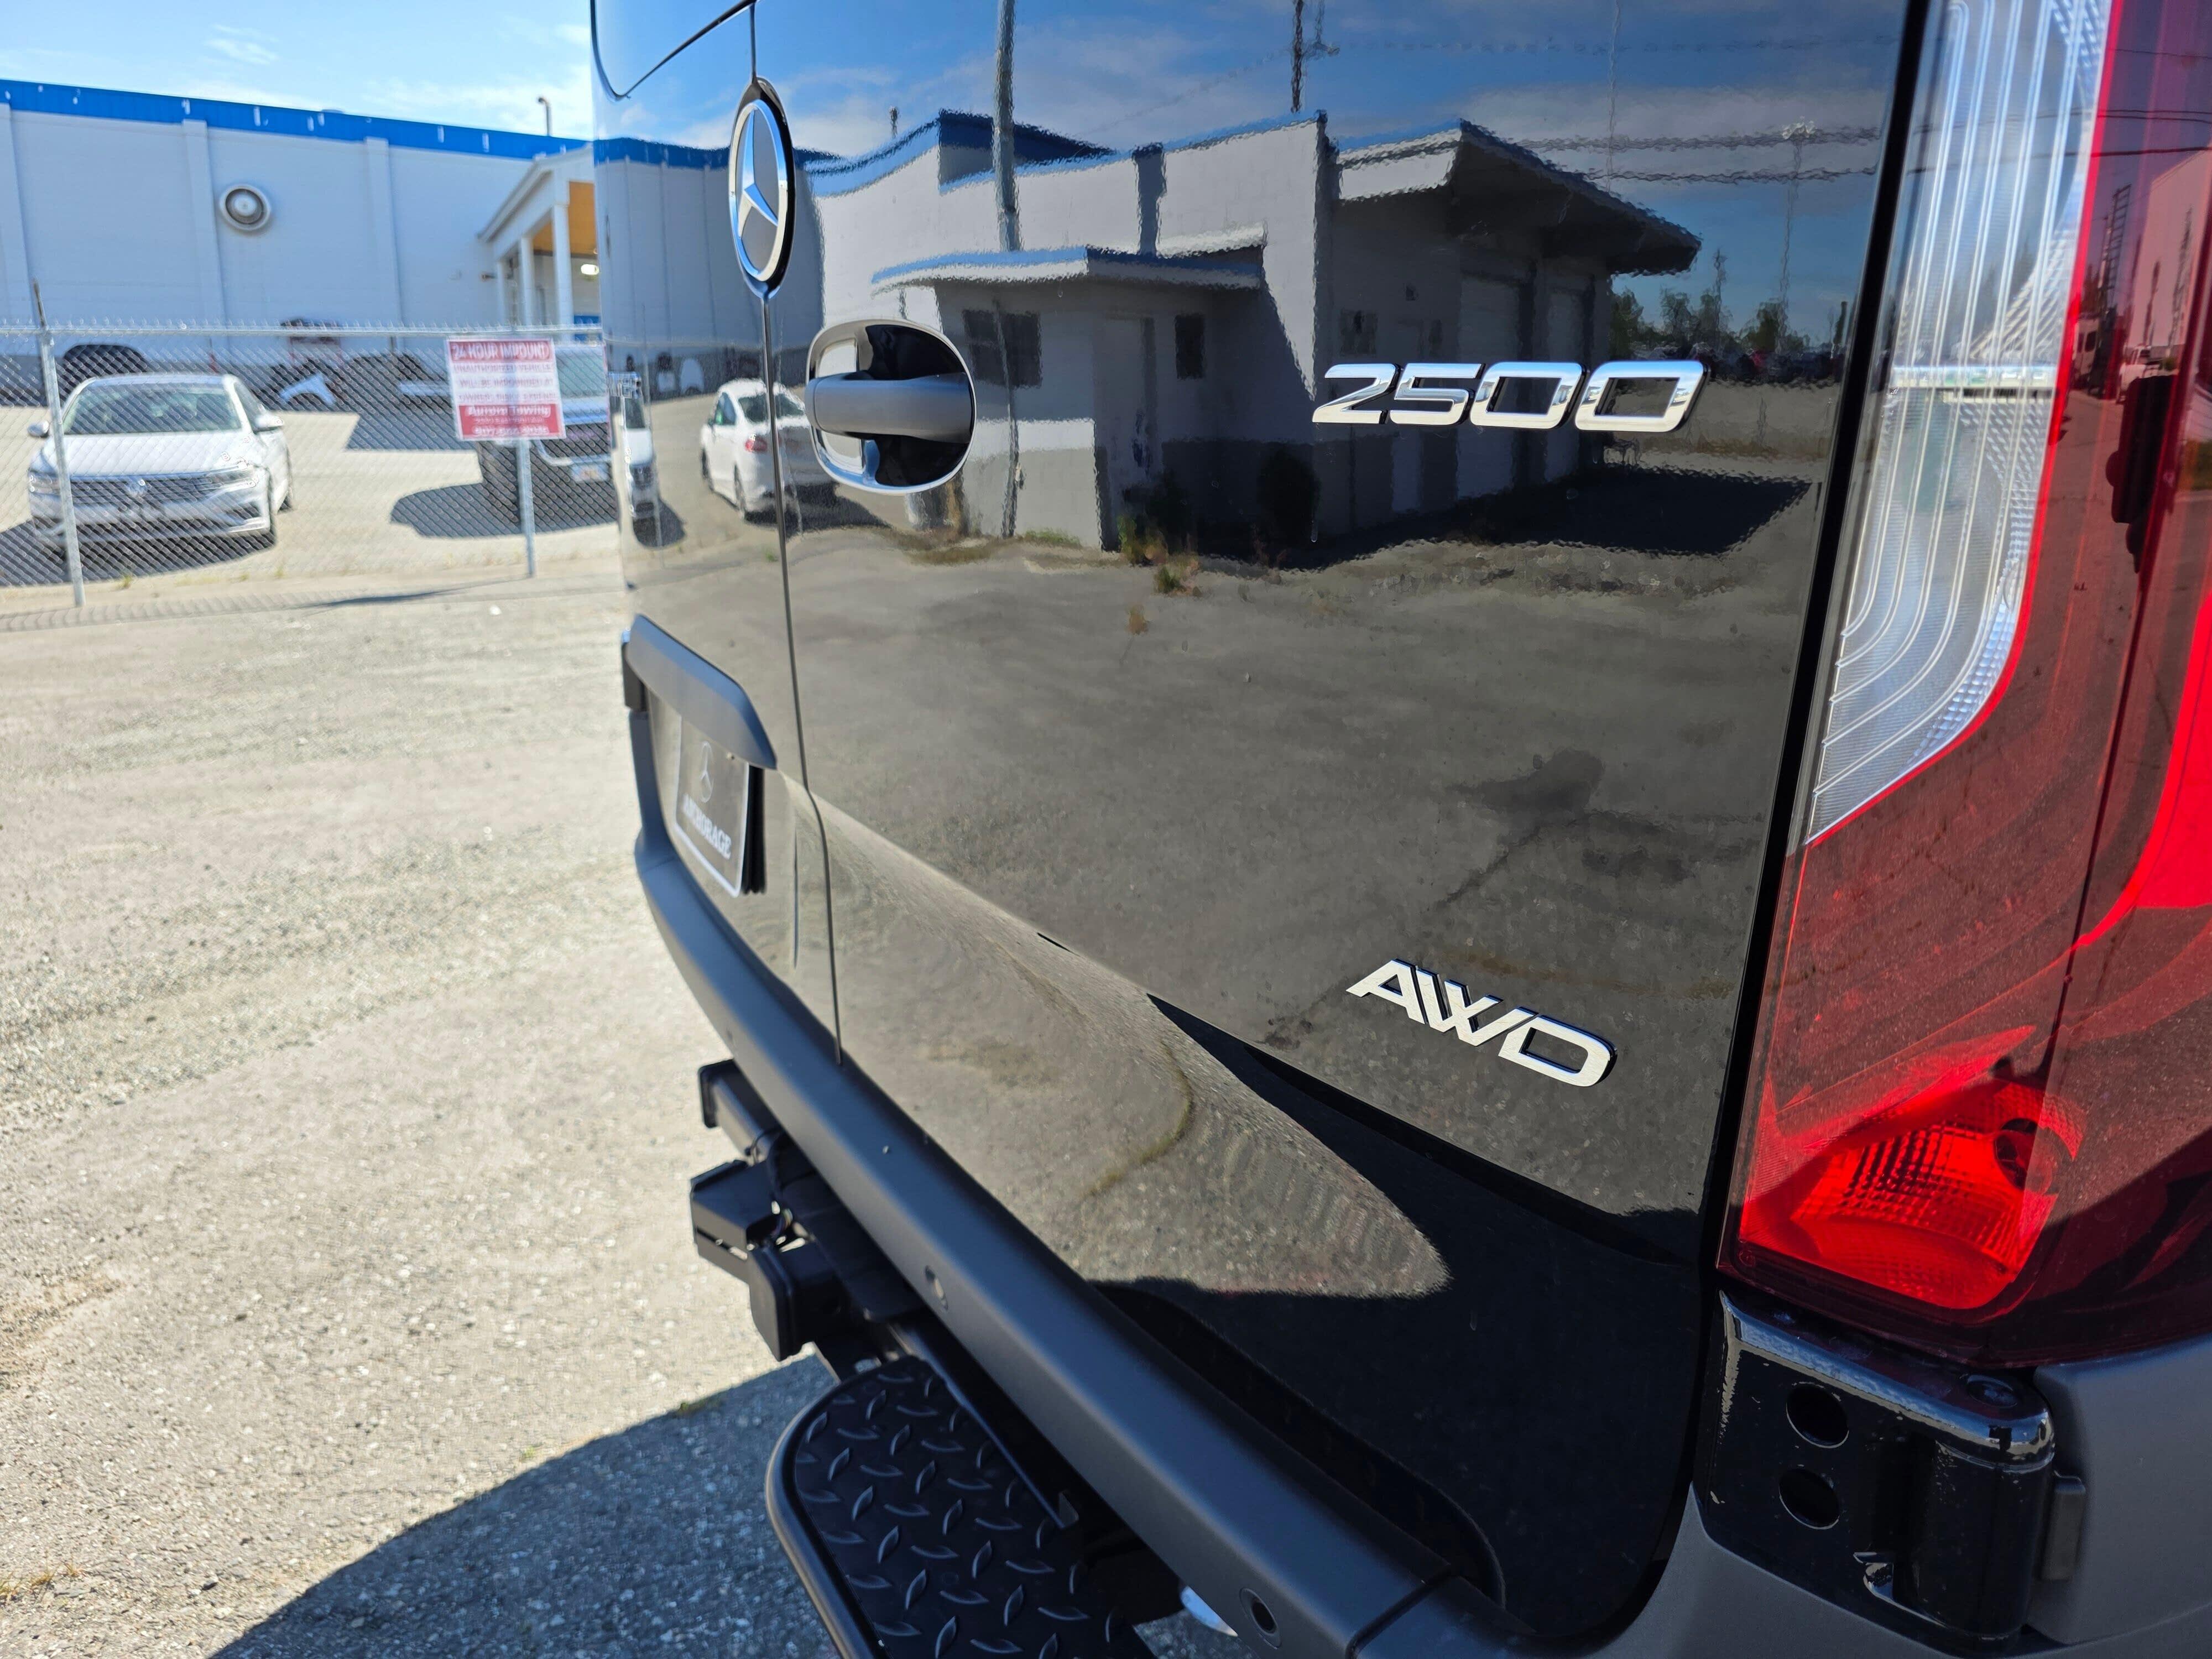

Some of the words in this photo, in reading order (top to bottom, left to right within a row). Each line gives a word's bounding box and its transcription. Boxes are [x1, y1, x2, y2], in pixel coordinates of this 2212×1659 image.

[451, 343, 465, 359] 24
[468, 342, 498, 359] HOUR
[500, 342, 550, 360] IMPOUND
[509, 405, 551, 419] Towing
[1312, 361, 1710, 432] 2500
[682, 792, 732, 860] ANCHORAGE
[1345, 958, 1618, 1087] AWD
